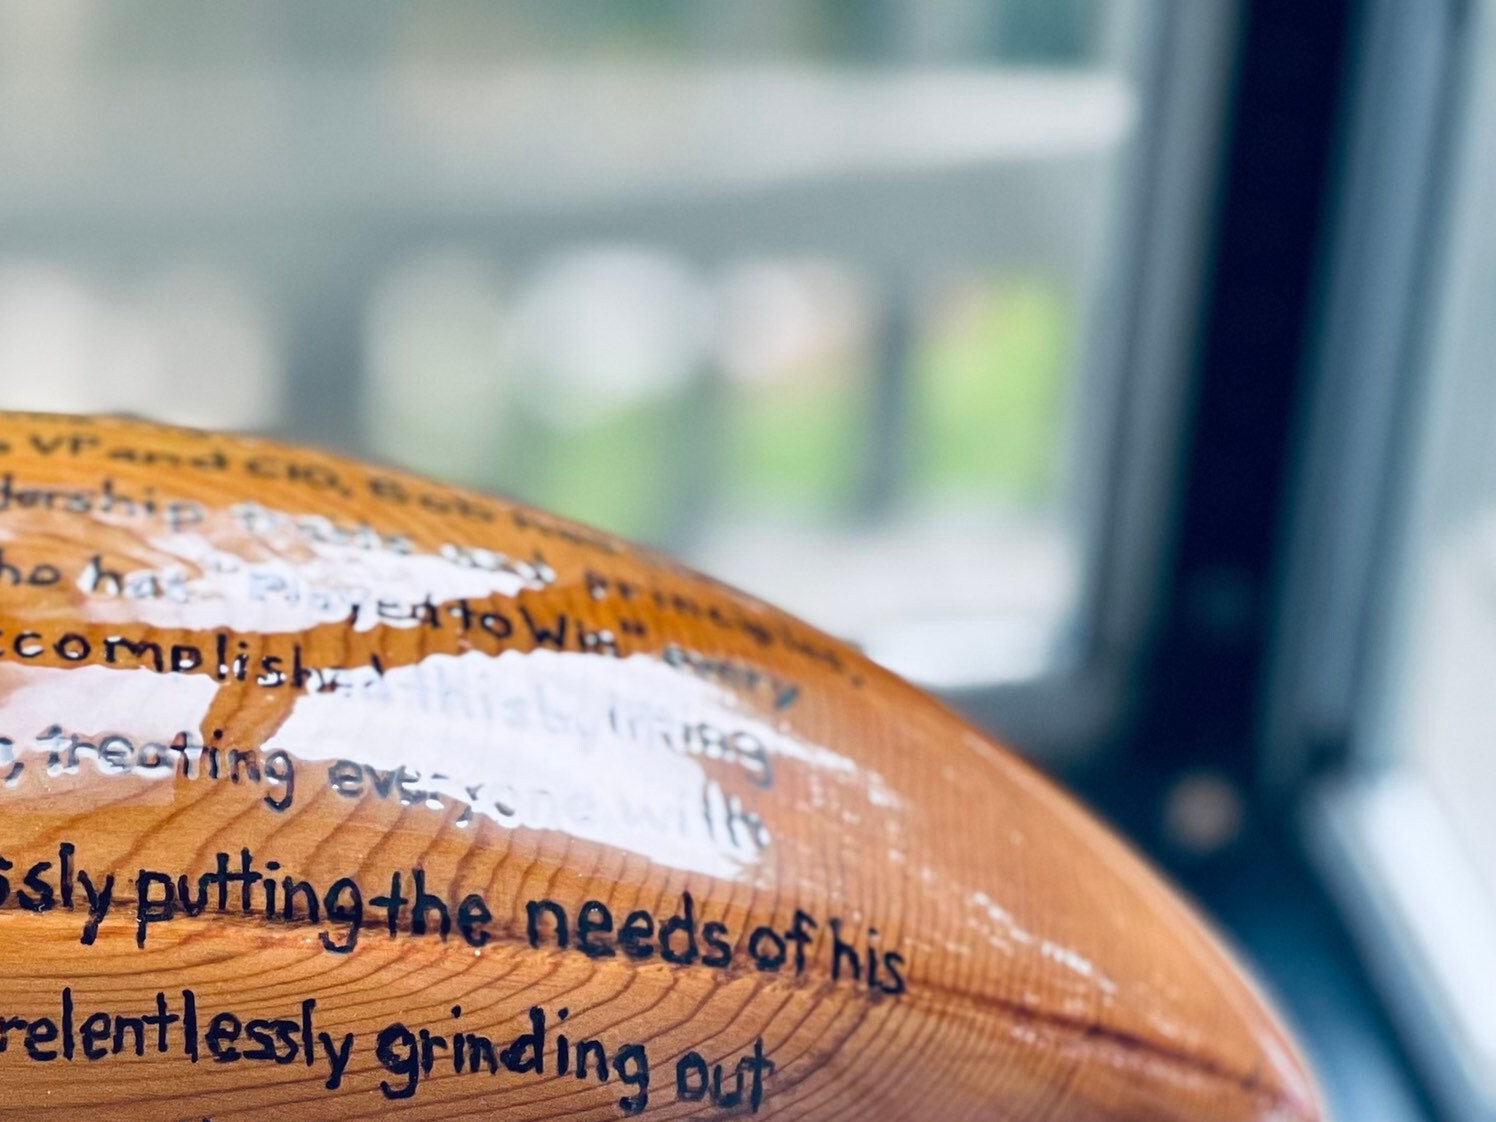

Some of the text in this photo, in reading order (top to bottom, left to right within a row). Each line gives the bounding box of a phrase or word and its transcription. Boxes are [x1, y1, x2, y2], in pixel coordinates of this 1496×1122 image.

[34, 722, 296, 812] treating
[135, 845, 366, 953] putting
[368, 866, 495, 949] the
[524, 888, 733, 970] needs
[747, 907, 818, 976] of
[829, 916, 906, 996] his
[375, 1004, 650, 1115] grinding
[675, 1035, 775, 1114] out
